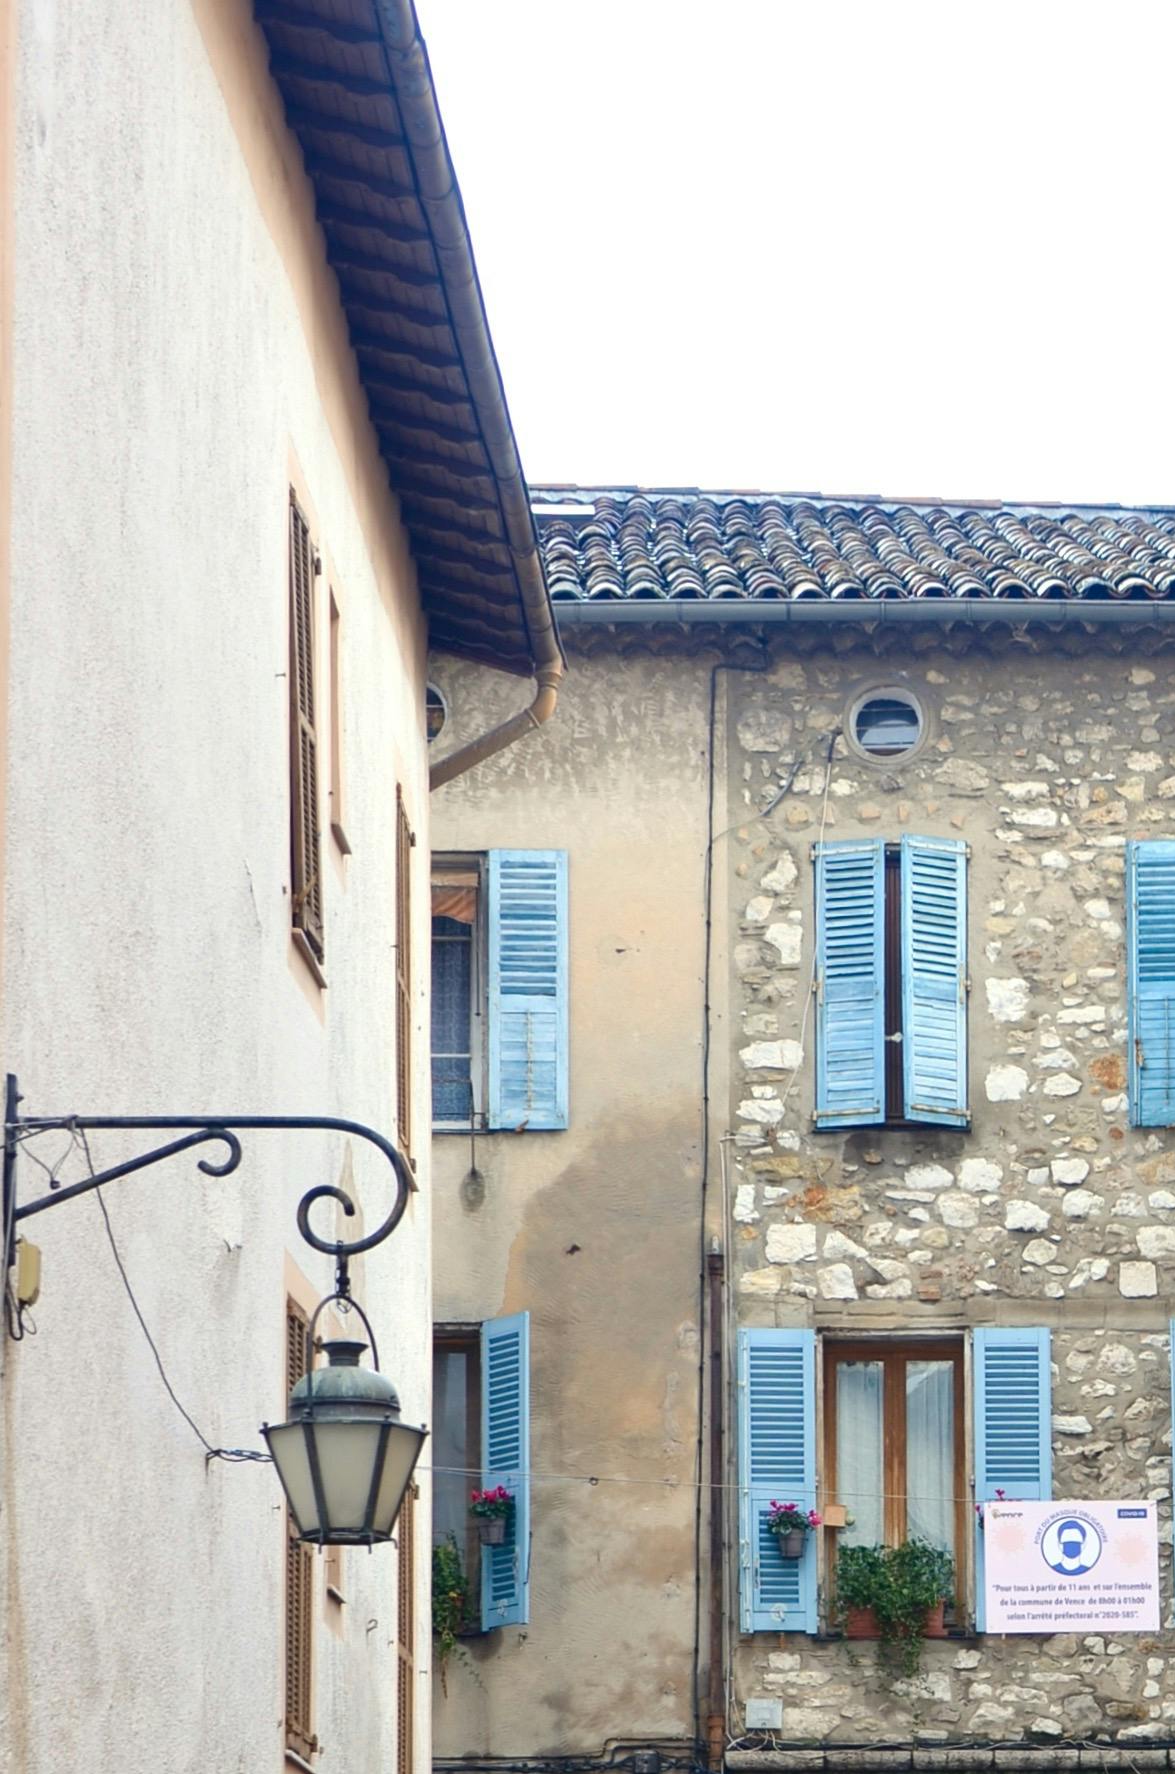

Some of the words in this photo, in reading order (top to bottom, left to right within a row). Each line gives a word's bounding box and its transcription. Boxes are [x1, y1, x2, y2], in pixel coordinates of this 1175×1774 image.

[1049, 1509, 1077, 1519] MASQUE
[1065, 1597, 1085, 1605] Vence
[1088, 1597, 1096, 1605] de
[1007, 1612, 1025, 1620] selon
